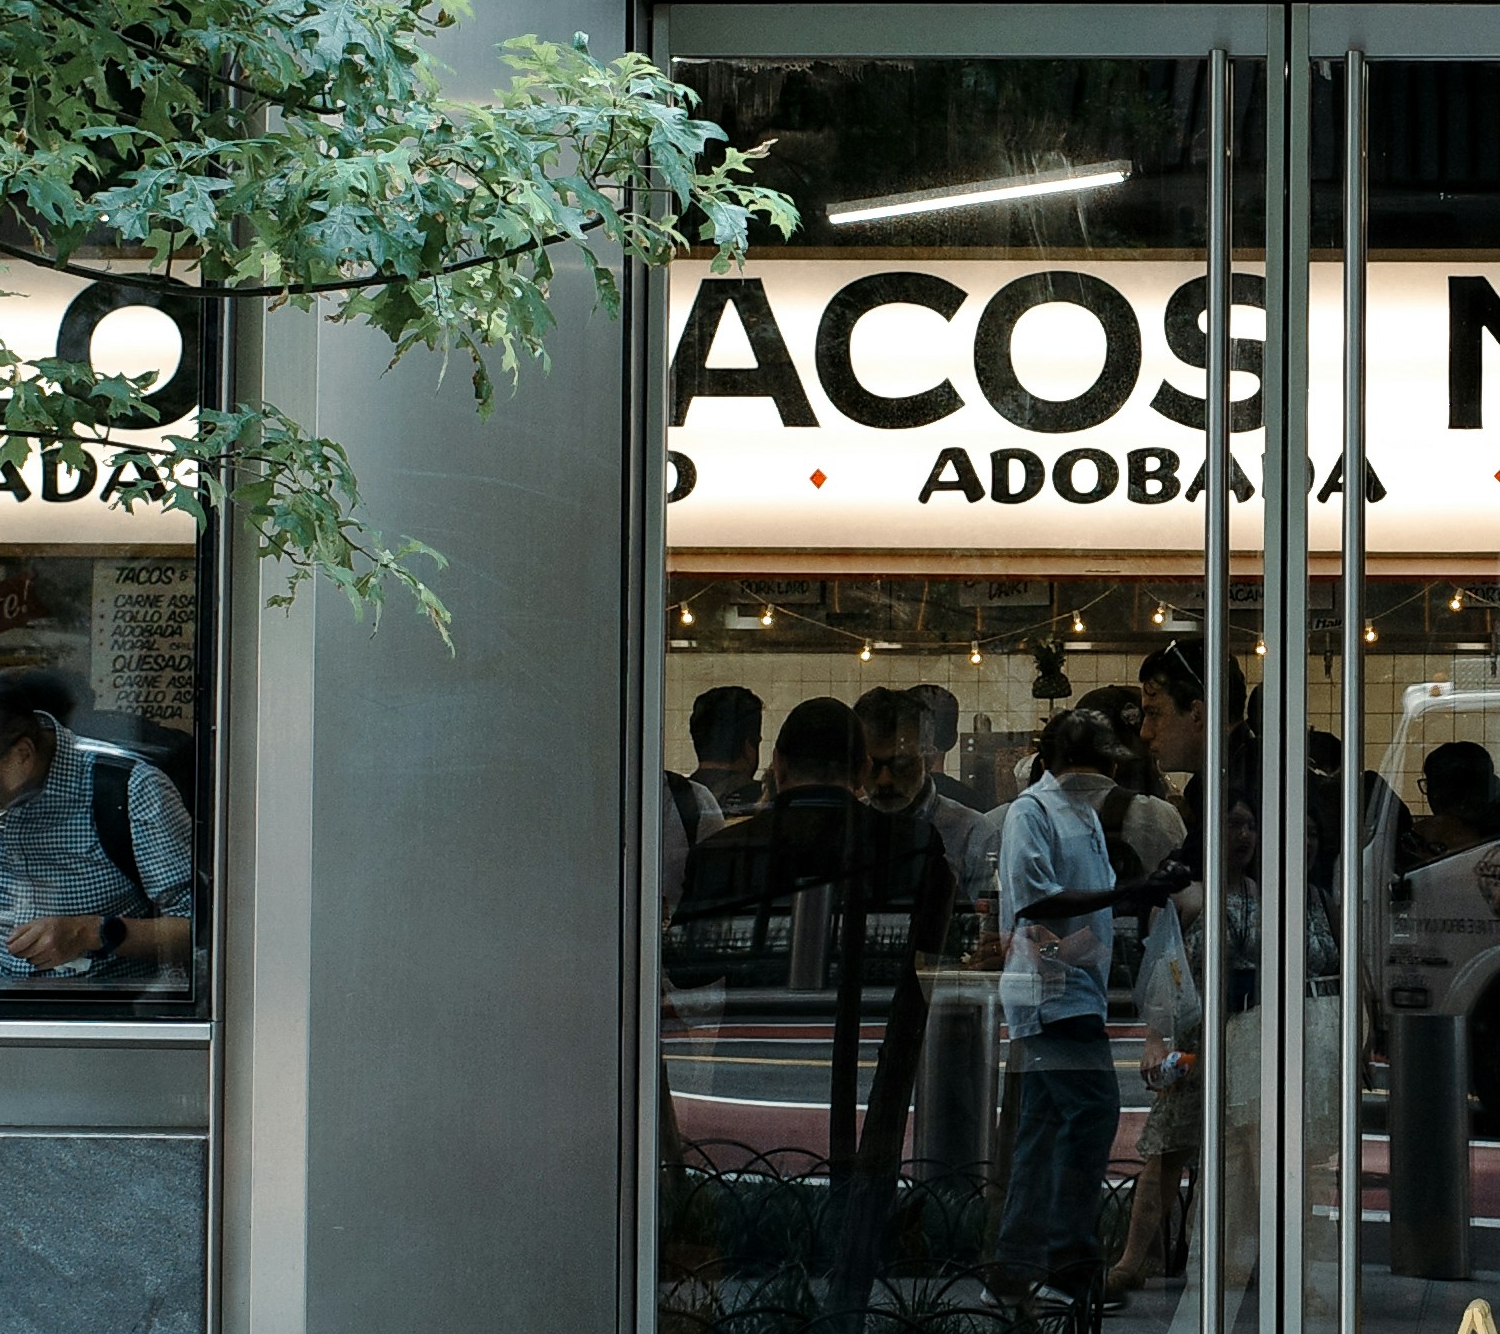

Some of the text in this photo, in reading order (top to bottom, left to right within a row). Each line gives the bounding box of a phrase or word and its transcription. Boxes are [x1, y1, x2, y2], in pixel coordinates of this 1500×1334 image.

[115, 566, 175, 585] TACOS
[114, 594, 164, 609] CARNE
[112, 610, 162, 623] POLLO
[111, 624, 183, 638] ADOBADA
[110, 639, 160, 651] NOPAL
[113, 674, 162, 689] CARNE
[115, 690, 166, 704] POLLO
